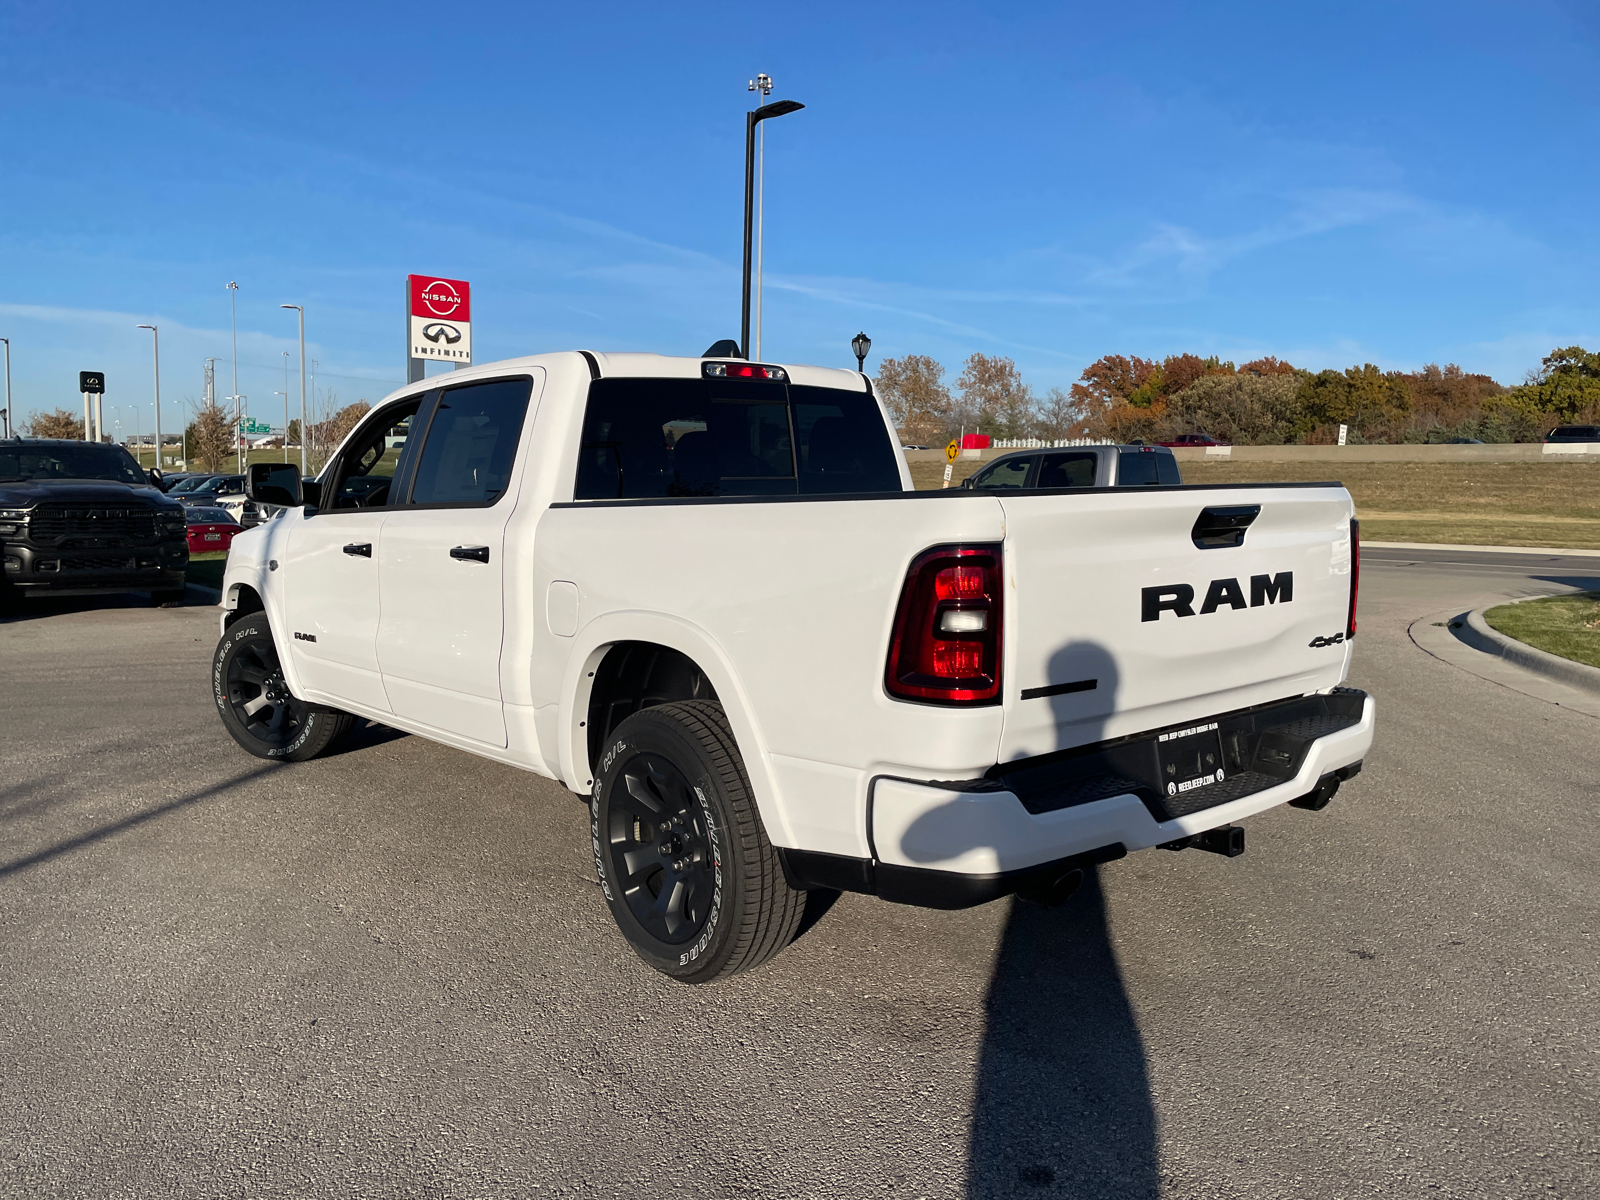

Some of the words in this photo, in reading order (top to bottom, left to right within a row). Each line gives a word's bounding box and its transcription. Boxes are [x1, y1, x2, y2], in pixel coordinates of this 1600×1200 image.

[421, 292, 461, 304] NISSAN
[414, 346, 470, 359] INFINITI
[1141, 571, 1293, 622] RAM
[294, 631, 317, 643] RAM
[214, 640, 232, 709] DUELER
[267, 712, 316, 756] GESTONE
[1169, 732, 1177, 740] JEEP
[1178, 774, 1215, 793] REEDJEEP.COM
[592, 778, 614, 901] DUELER
[679, 786, 723, 966] BRIDGESTONE
